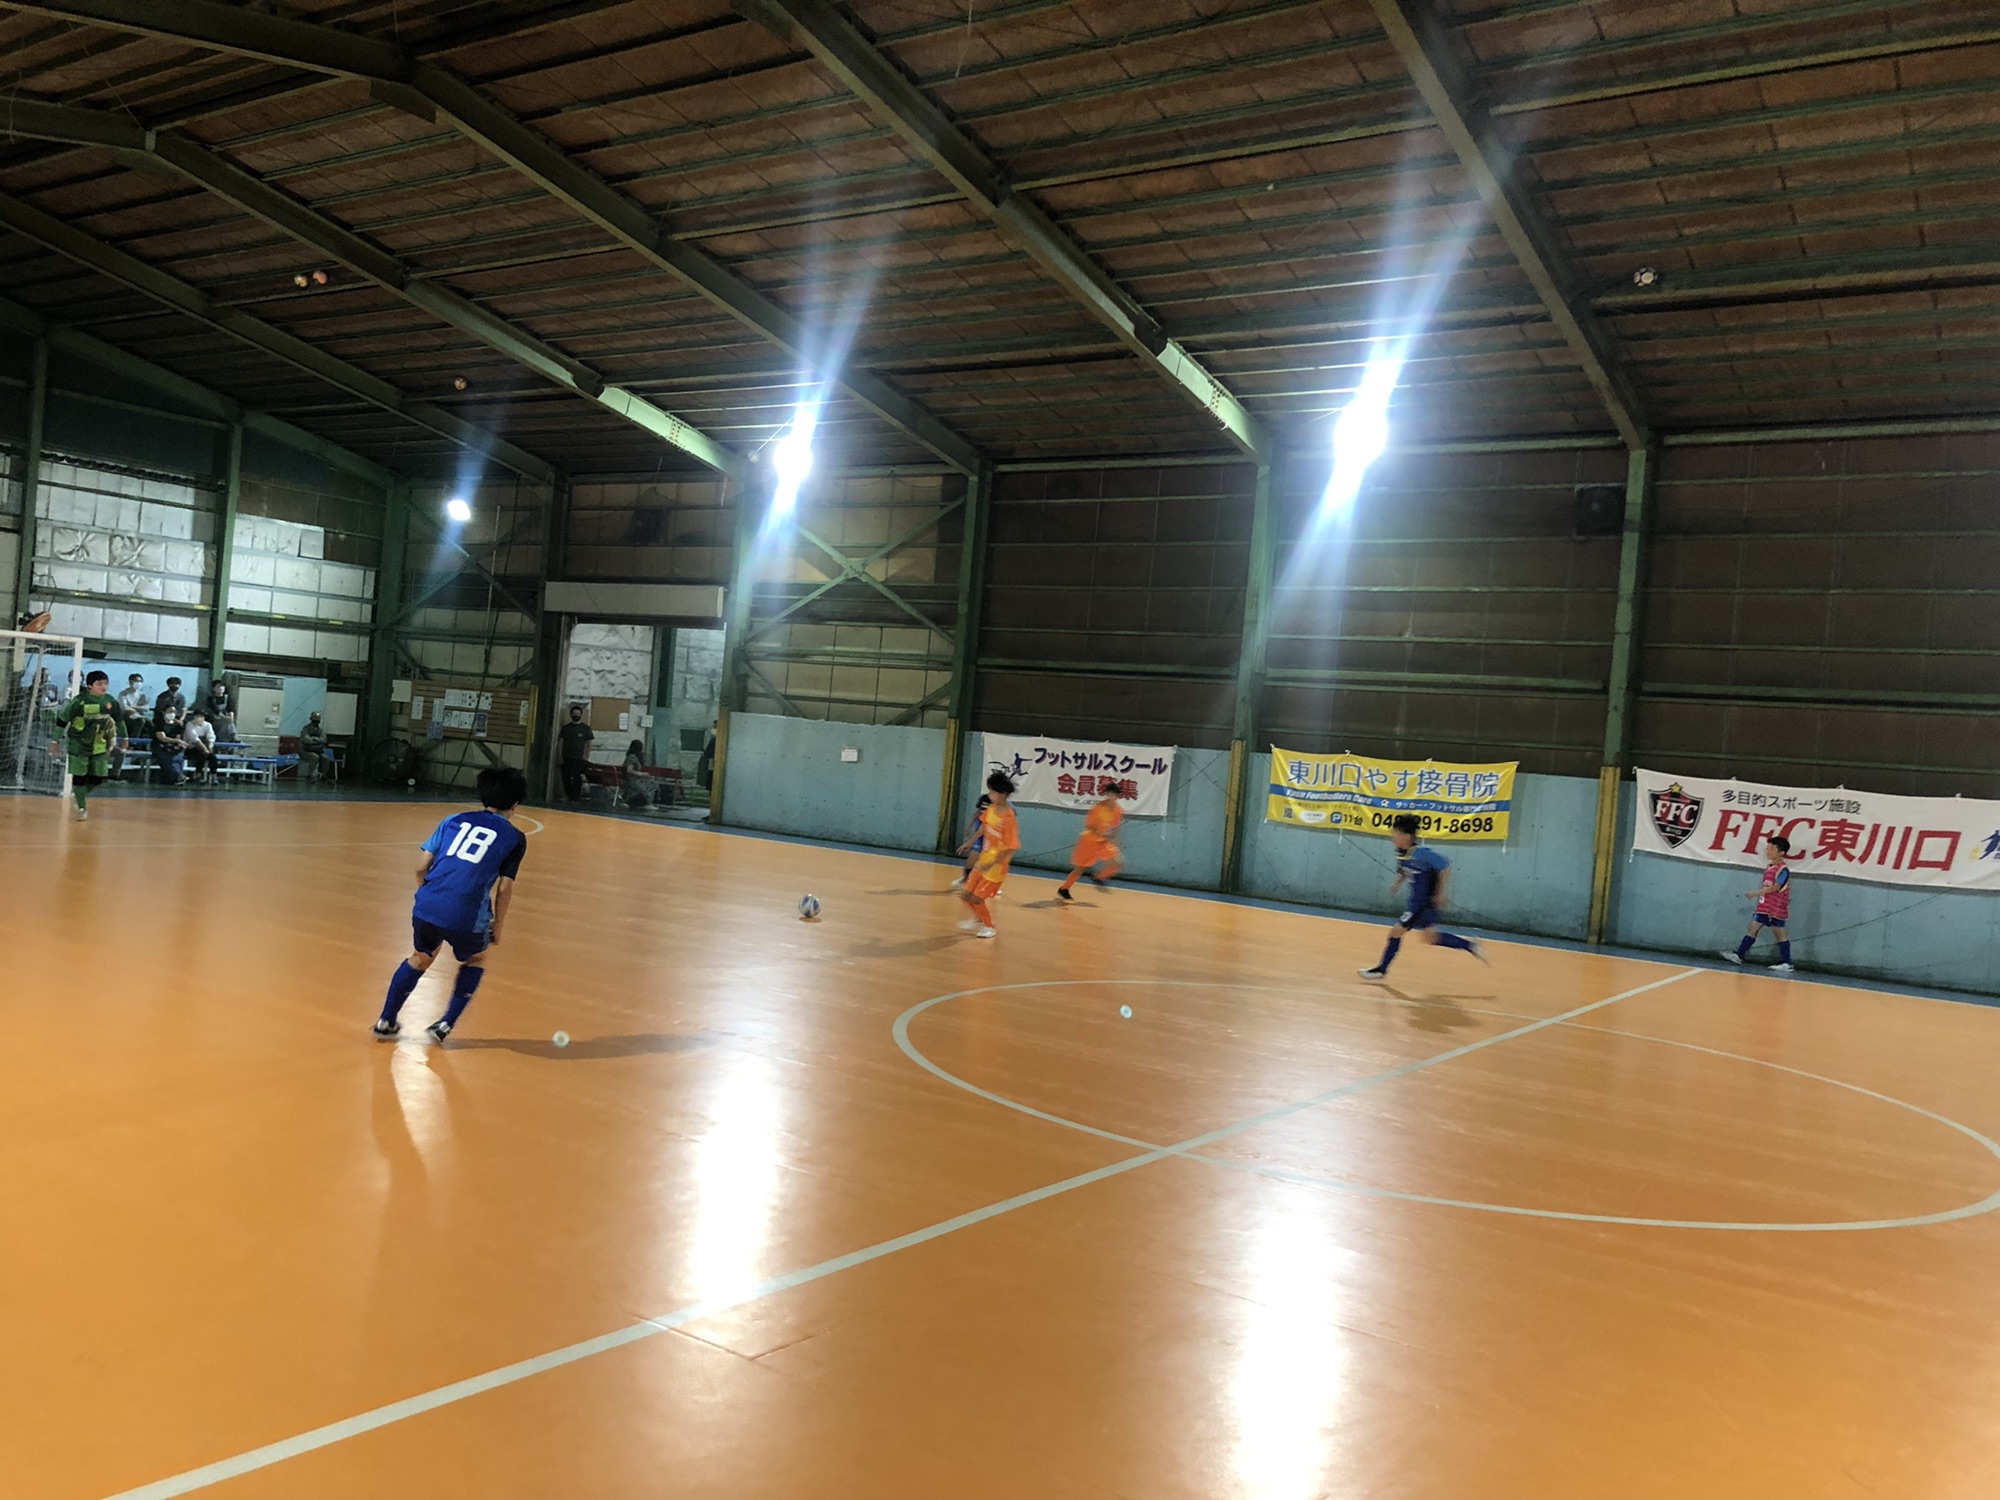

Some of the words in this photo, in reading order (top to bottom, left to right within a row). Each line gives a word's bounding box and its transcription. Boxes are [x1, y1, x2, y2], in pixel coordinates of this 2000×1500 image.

[1033, 747, 1169, 776] フットサルスクール
[1286, 759, 1500, 799] 東川口やす接骨院
[1653, 799, 1699, 824] FFC
[1721, 789, 1862, 815] 多目的スポーツ施設
[1343, 813, 1364, 826] 11台
[446, 821, 498, 864] 18
[1708, 808, 1962, 872] FFC東川口
